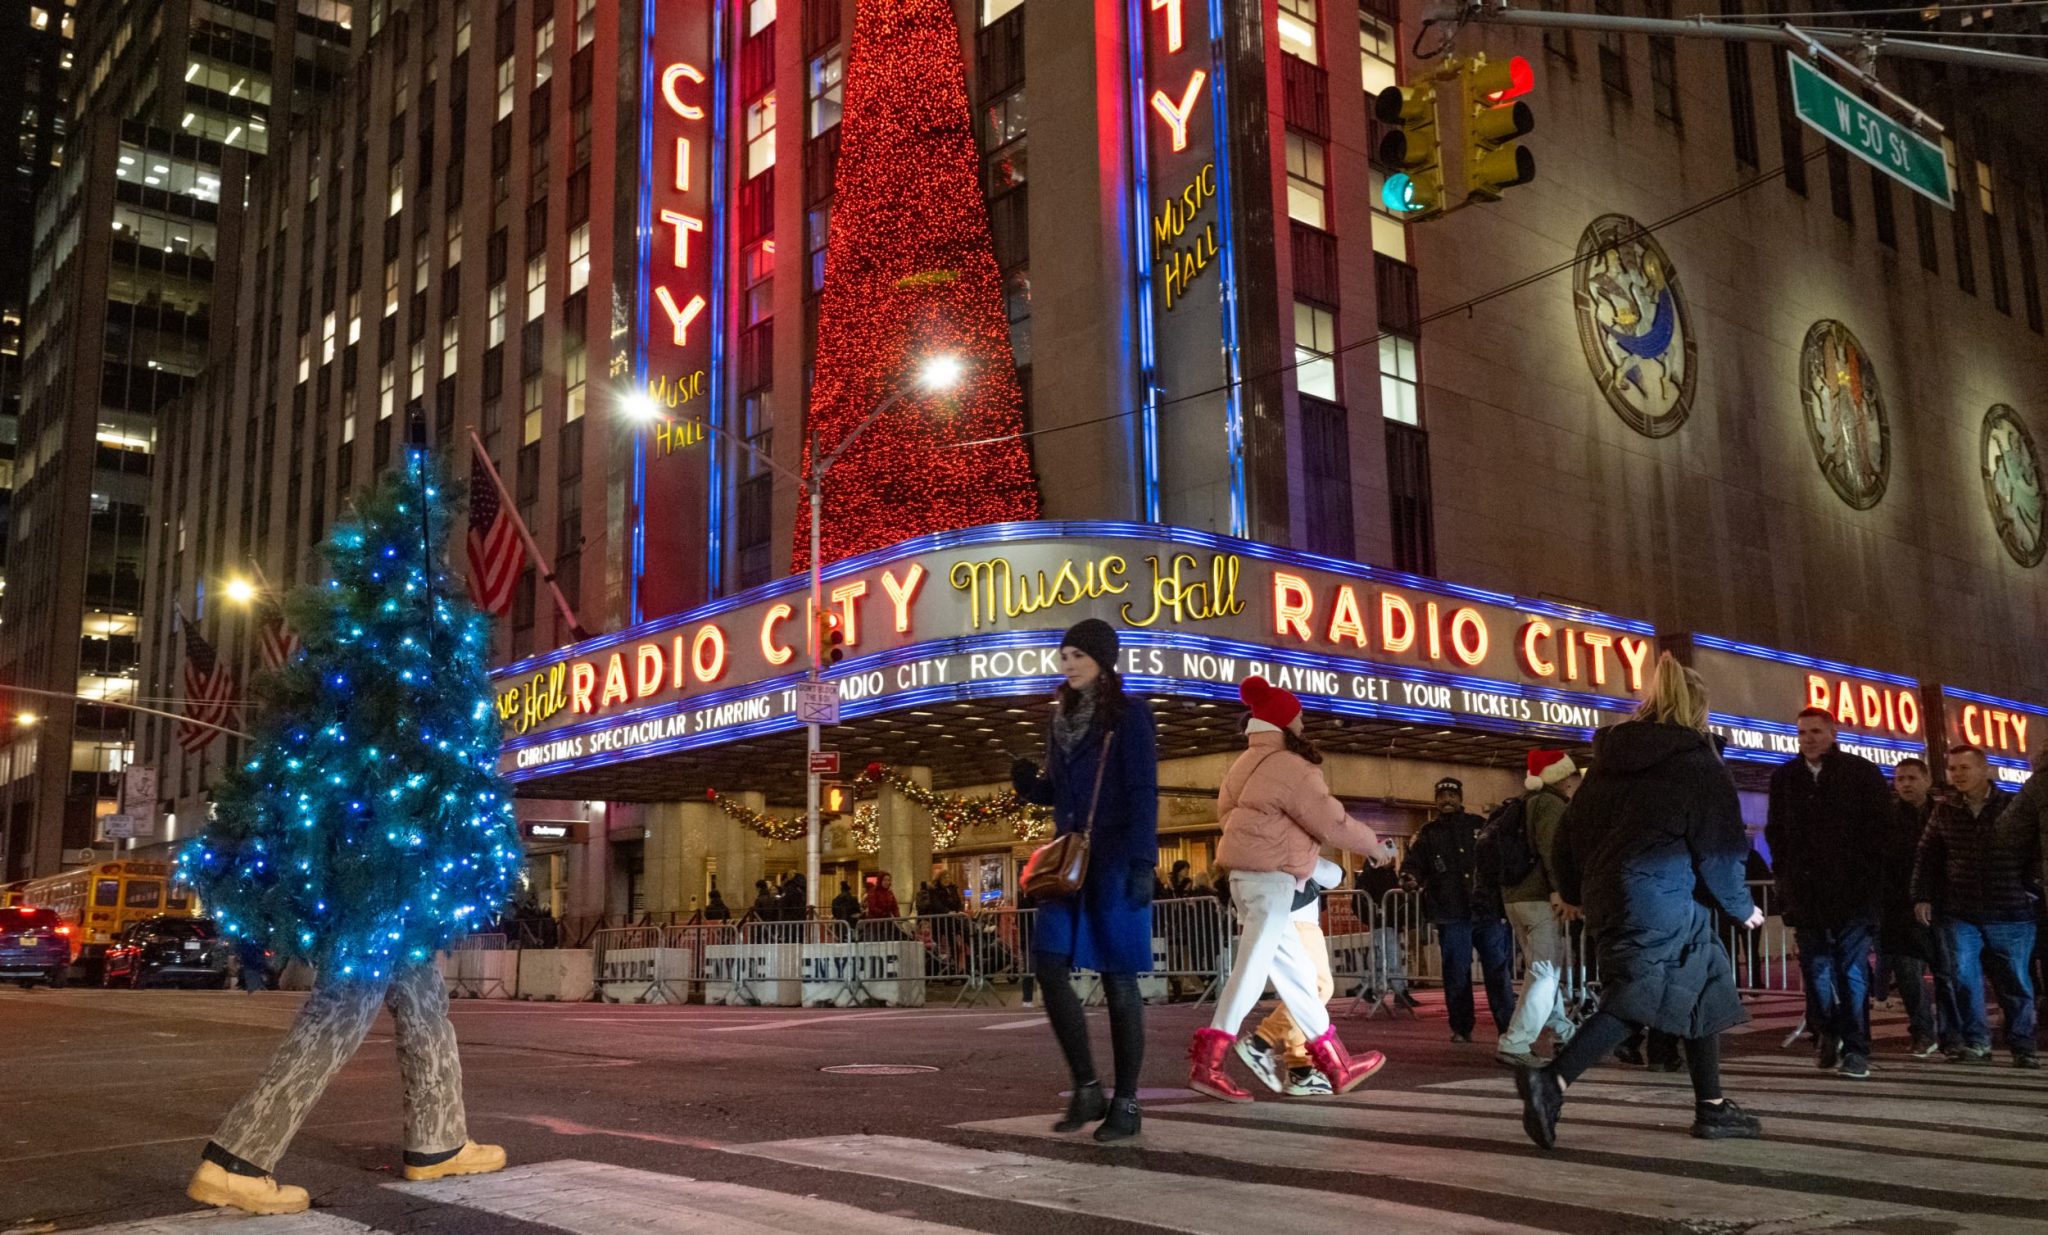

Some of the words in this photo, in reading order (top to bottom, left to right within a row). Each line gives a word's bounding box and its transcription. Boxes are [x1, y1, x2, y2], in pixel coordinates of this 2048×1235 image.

[1834, 95, 1851, 135] W
[1857, 111, 1883, 156] 50
[1888, 131, 1911, 173] St
[655, 62, 706, 347] CITY
[1154, 163, 1216, 260] MUSIC
[1165, 224, 1219, 309] HALL
[650, 369, 705, 408] MUSIC
[656, 415, 705, 457] HALL
[950, 554, 1129, 630] Music
[1121, 554, 1246, 628] Hall
[1272, 570, 1489, 668] RADIO
[1523, 619, 1650, 692] CITY
[514, 661, 567, 735] Hall
[517, 736, 583, 768] CHRISTMAS
[589, 714, 686, 751] SPECTACULAR
[694, 696, 771, 732] STARRING
[828, 671, 884, 700] ADIO
[896, 658, 948, 691] CITY
[970, 648, 1164, 679] ROCKES
[1182, 654, 1236, 683] NOW
[1249, 660, 1340, 695] PLAYING
[1352, 674, 1389, 700] GET
[1402, 682, 1452, 709] YOUR
[1461, 690, 1531, 719] TICKETS
[1541, 702, 1600, 728] TODAY!
[571, 625, 727, 715] RADIO
[1731, 728, 1764, 749] YOUR
[1963, 703, 2030, 754] CITY
[814, 956, 884, 982] NYPD
